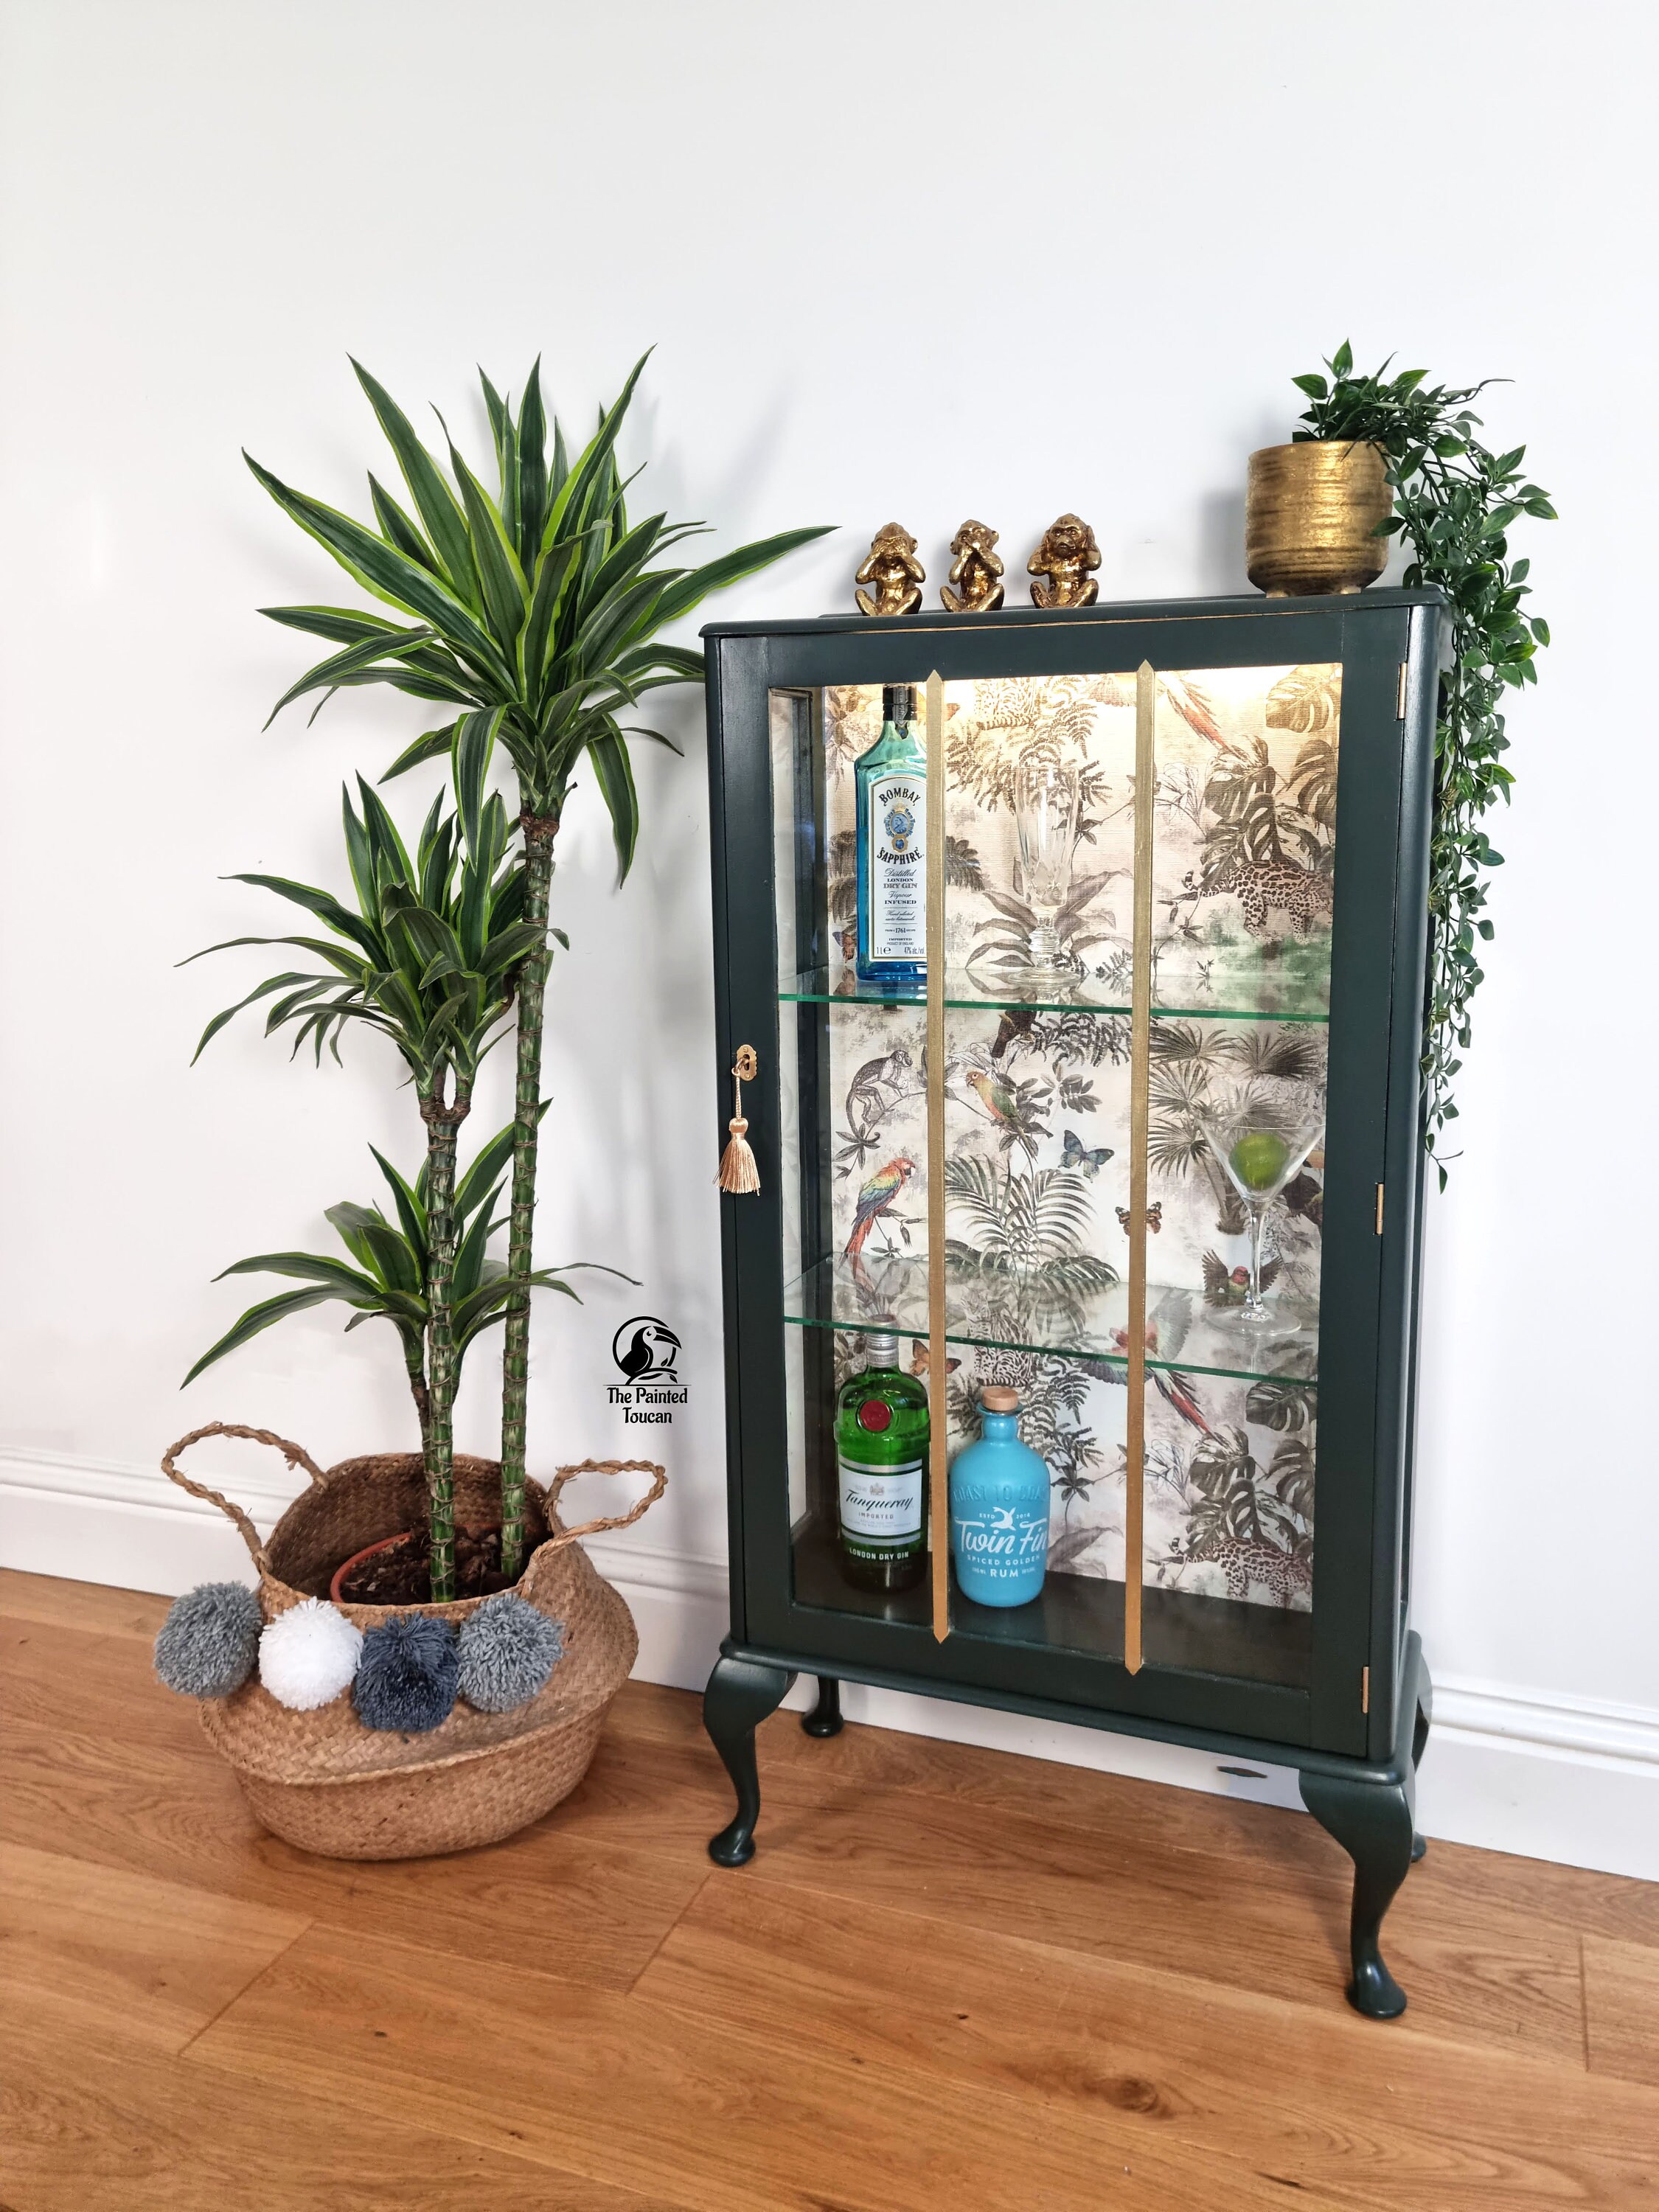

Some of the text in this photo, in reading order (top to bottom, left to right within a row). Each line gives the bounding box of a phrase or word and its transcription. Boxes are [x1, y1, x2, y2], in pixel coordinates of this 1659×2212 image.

[878, 787, 921, 807] BOMBAY
[877, 846, 922, 865] SAPPHIRE
[883, 867, 917, 877] Distilled
[888, 891, 912, 900] Vapour
[846, 1489, 914, 1511] Tanqueray
[858, 1512, 894, 1520] IMPORTED
[955, 1516, 1047, 1556] Twin Fin
[849, 1547, 876, 1560] LONDON
[897, 1551, 909, 1560] GIN
[967, 1554, 1040, 1566] SPICED GOLDEN
[990, 1568, 1019, 1578] RUM
